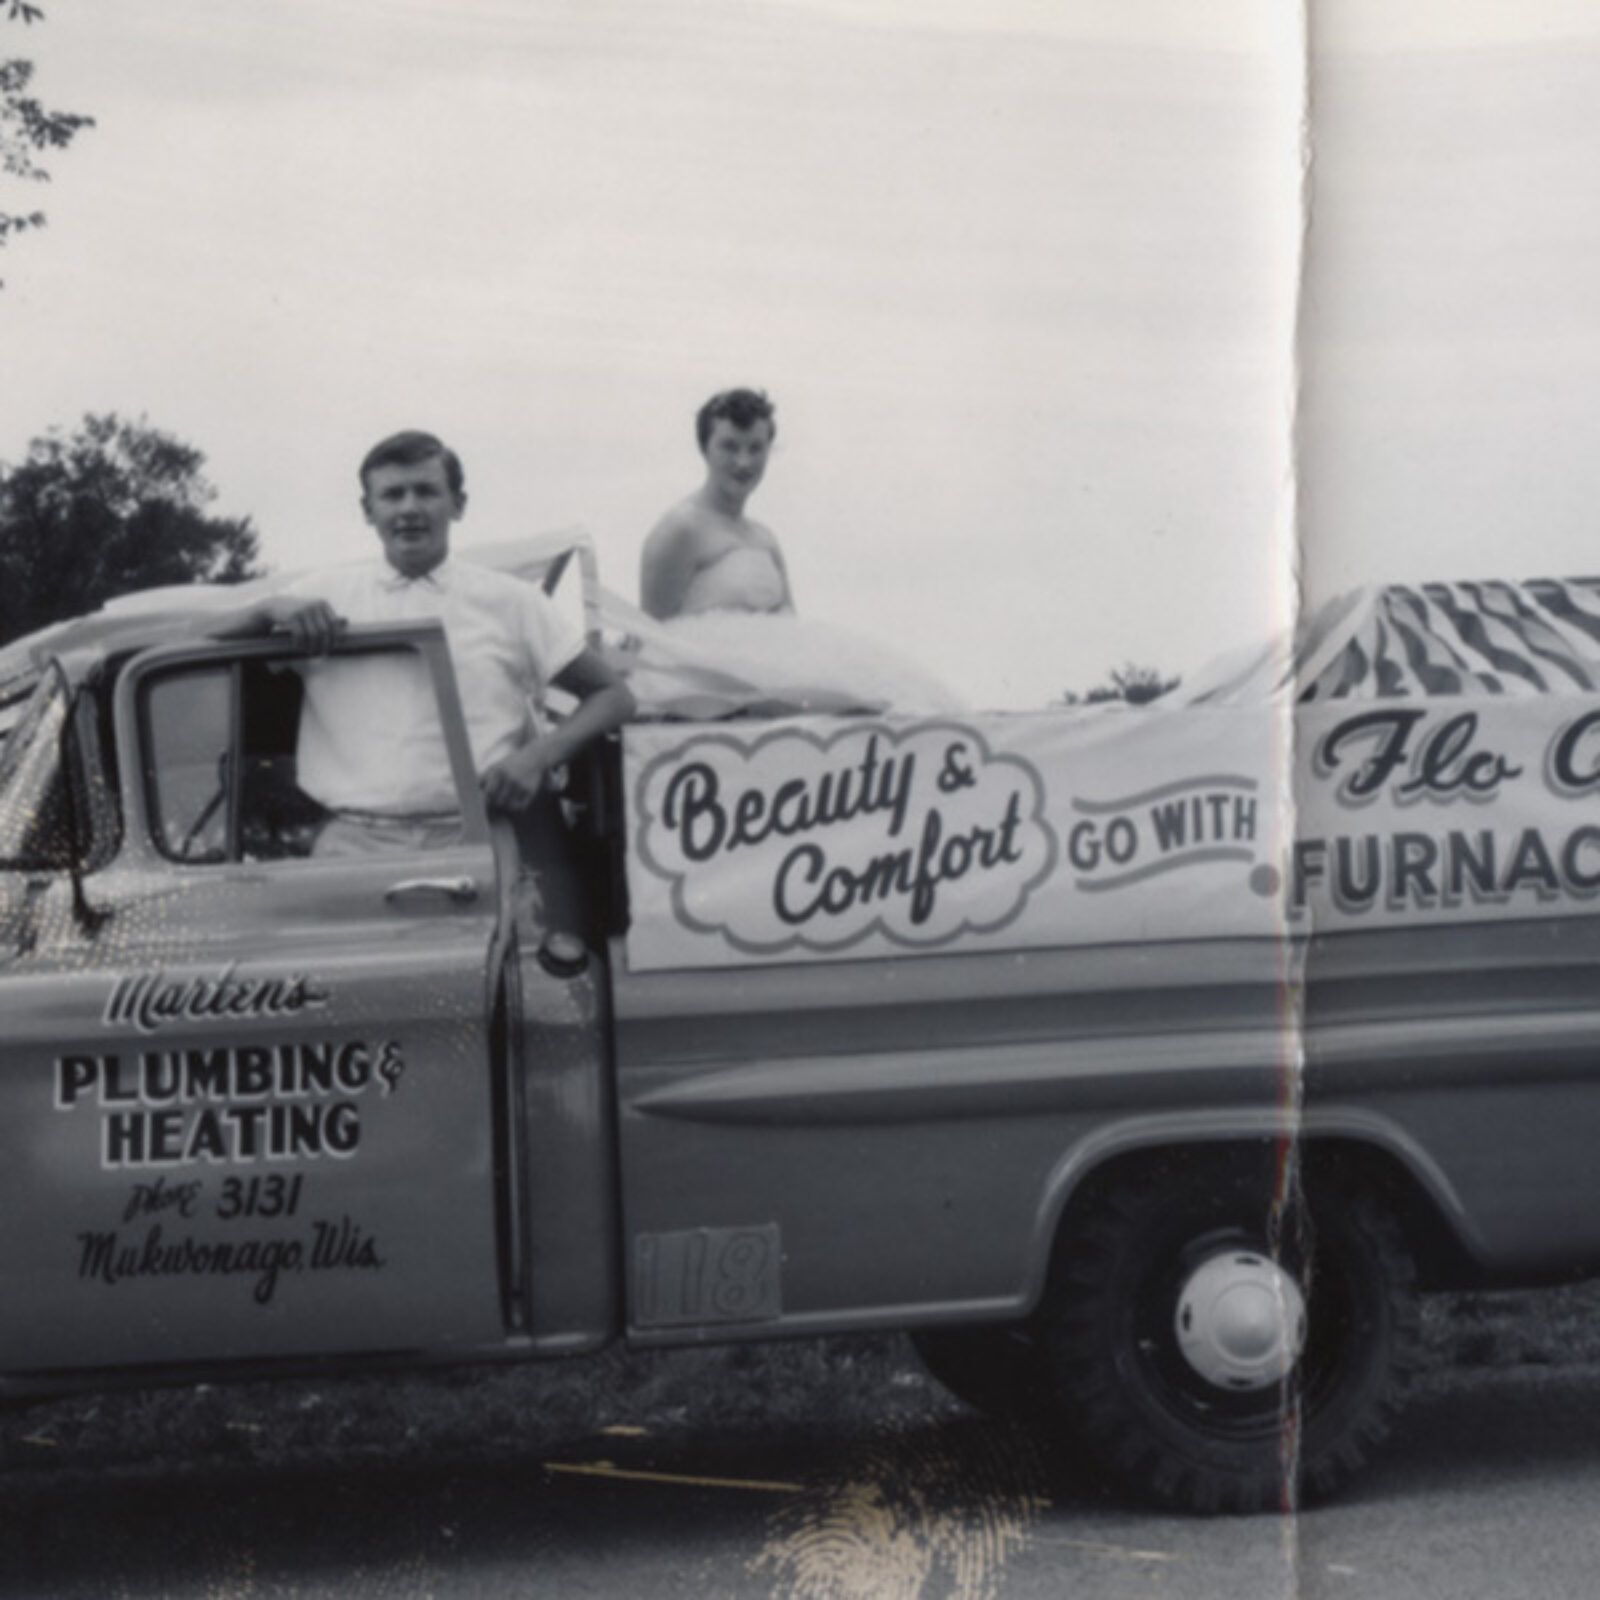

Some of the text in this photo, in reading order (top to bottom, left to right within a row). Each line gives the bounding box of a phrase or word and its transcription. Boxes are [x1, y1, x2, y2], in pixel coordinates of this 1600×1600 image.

[662, 733, 977, 862] Beauty &
[1316, 708, 1523, 803] Flo
[773, 790, 1022, 925] Comfort
[1068, 793, 1257, 872] GO WITH
[55, 1040, 405, 1110] PLUMBING &
[102, 1101, 360, 1168] HEATING
[216, 1173, 304, 1220] 3131
[636, 1231, 769, 1320] 118
